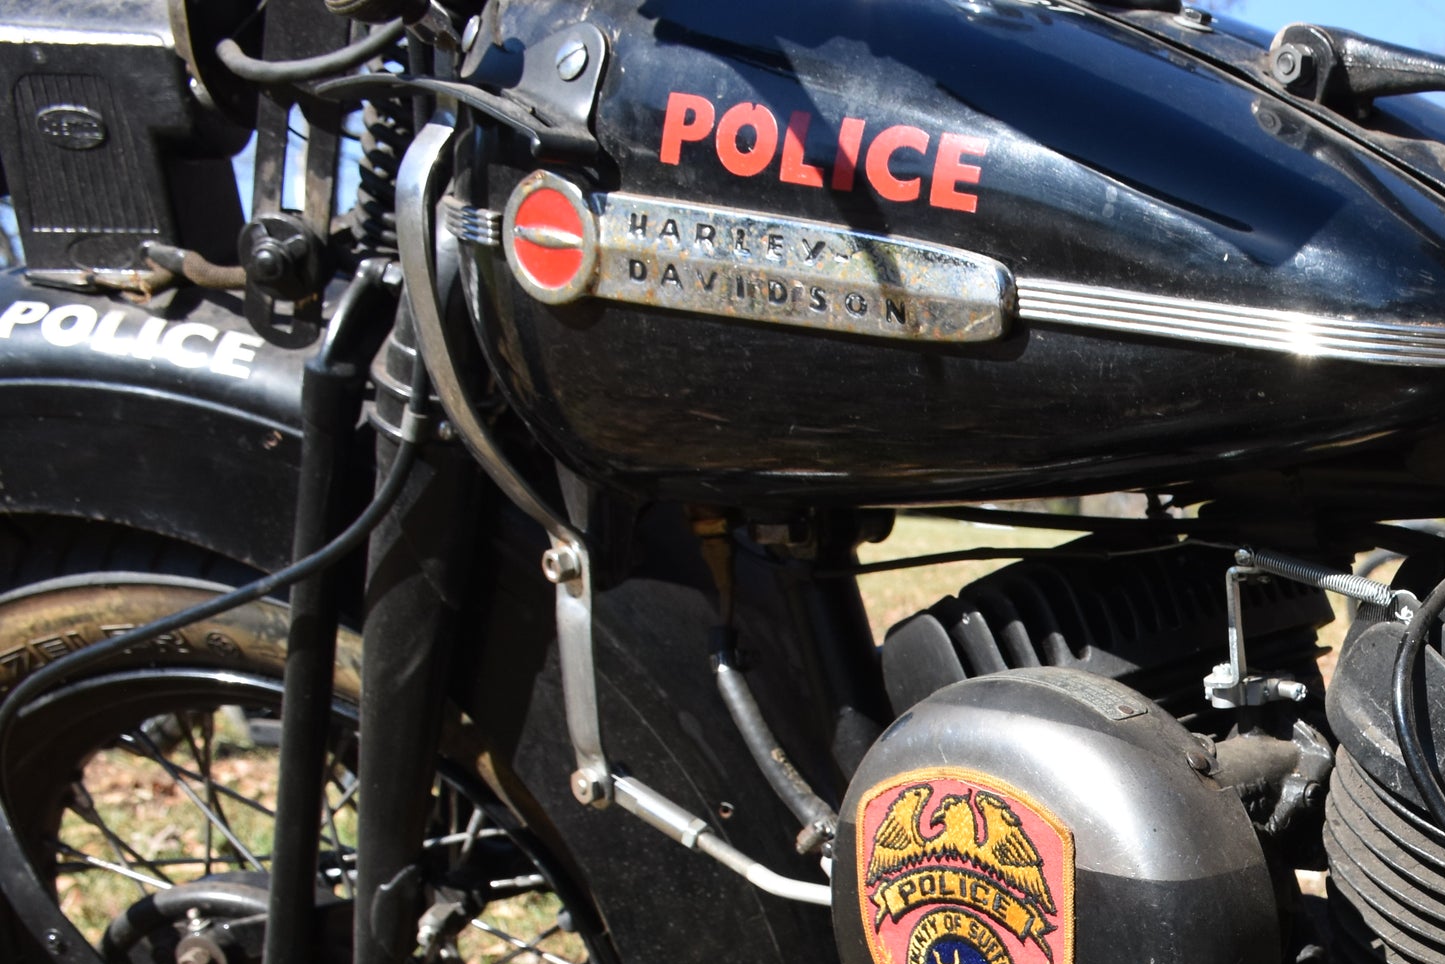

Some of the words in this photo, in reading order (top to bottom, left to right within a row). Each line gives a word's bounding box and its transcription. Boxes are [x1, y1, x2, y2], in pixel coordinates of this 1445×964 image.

[659, 91, 989, 213] POLICE
[628, 258, 906, 325] DAVIDSON
[0, 300, 265, 379] POLICE
[898, 873, 1011, 920] POLICE
[943, 914, 962, 934] OF
